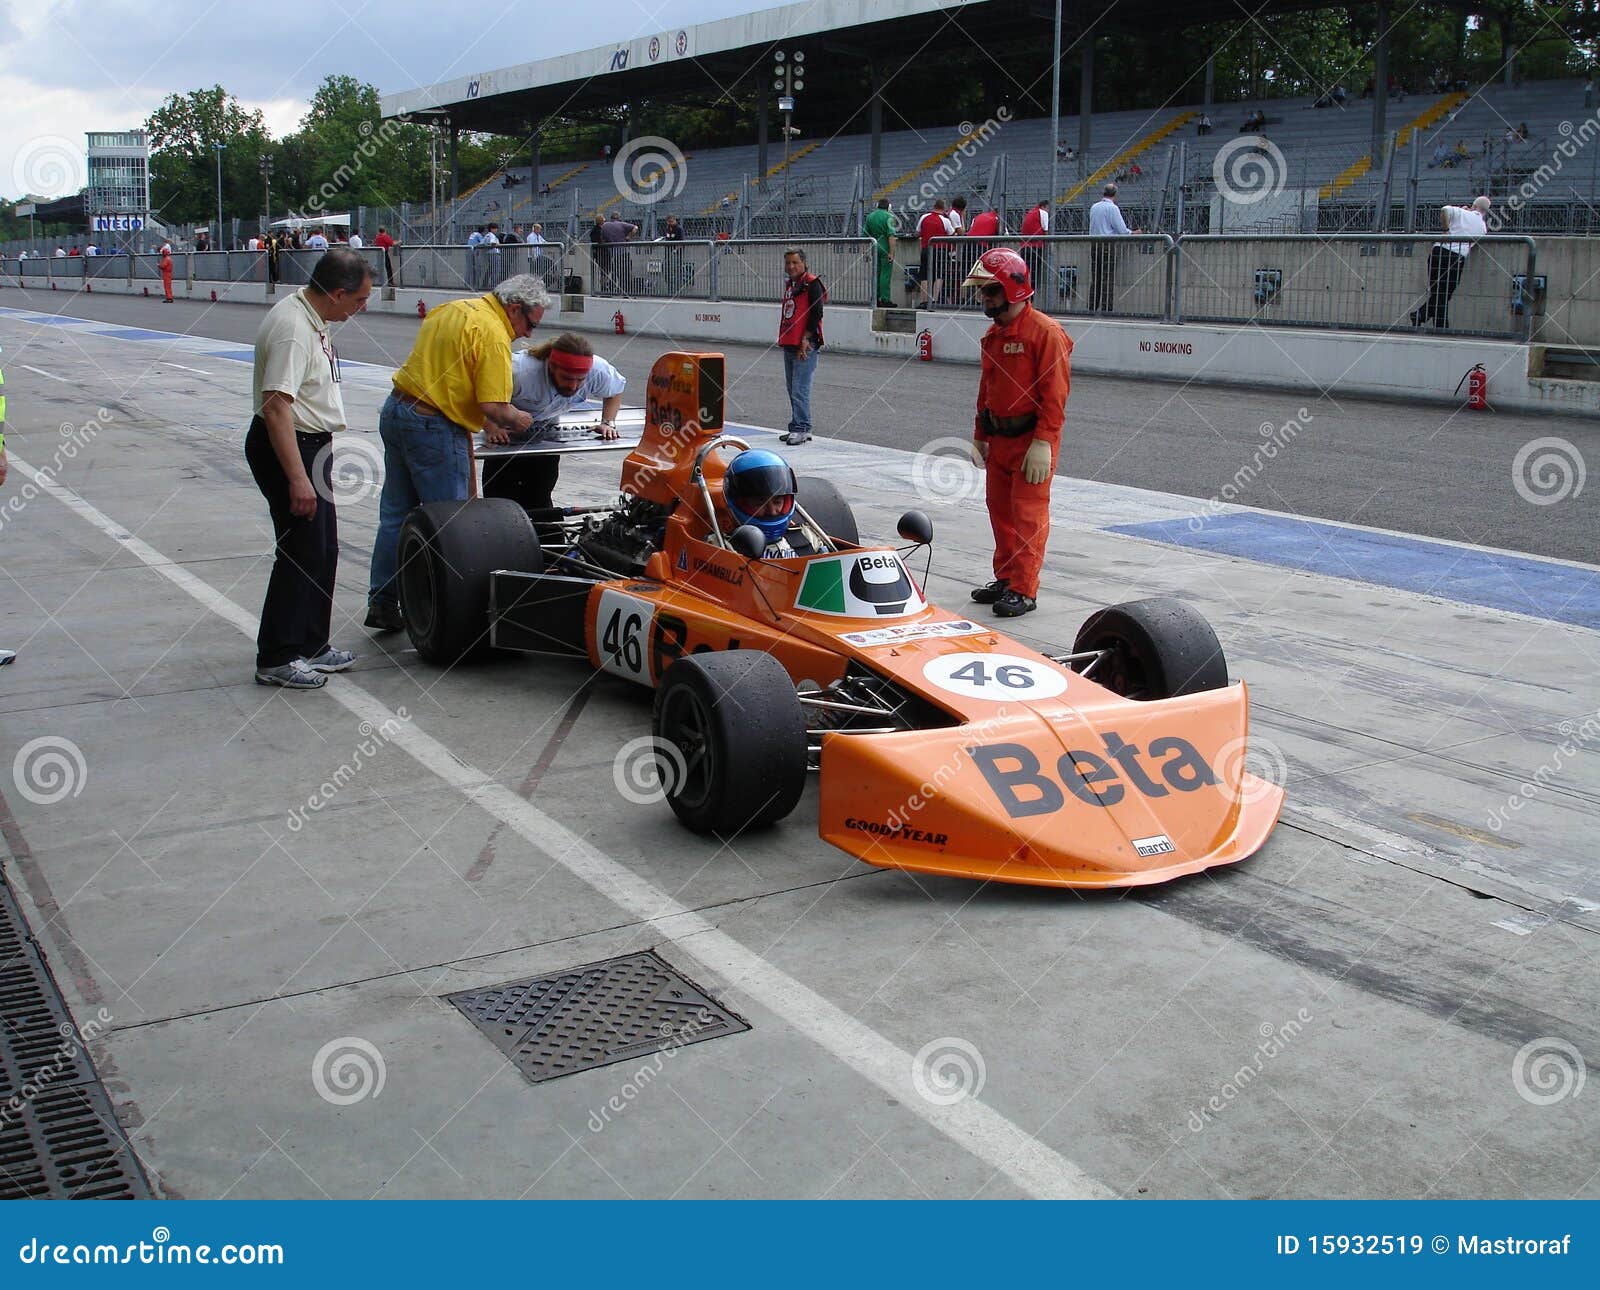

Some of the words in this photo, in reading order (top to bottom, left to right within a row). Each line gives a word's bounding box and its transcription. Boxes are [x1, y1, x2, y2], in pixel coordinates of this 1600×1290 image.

[96, 218, 142, 230] IVECO
[1139, 341, 1151, 352] NO
[1154, 342, 1192, 355] SMOKING
[860, 555, 896, 571] Beta
[603, 608, 642, 673] 46
[950, 660, 1035, 689] 46
[965, 731, 1224, 819] Beta
[844, 818, 949, 846] GOODYEAR
[1138, 840, 1173, 855] march
